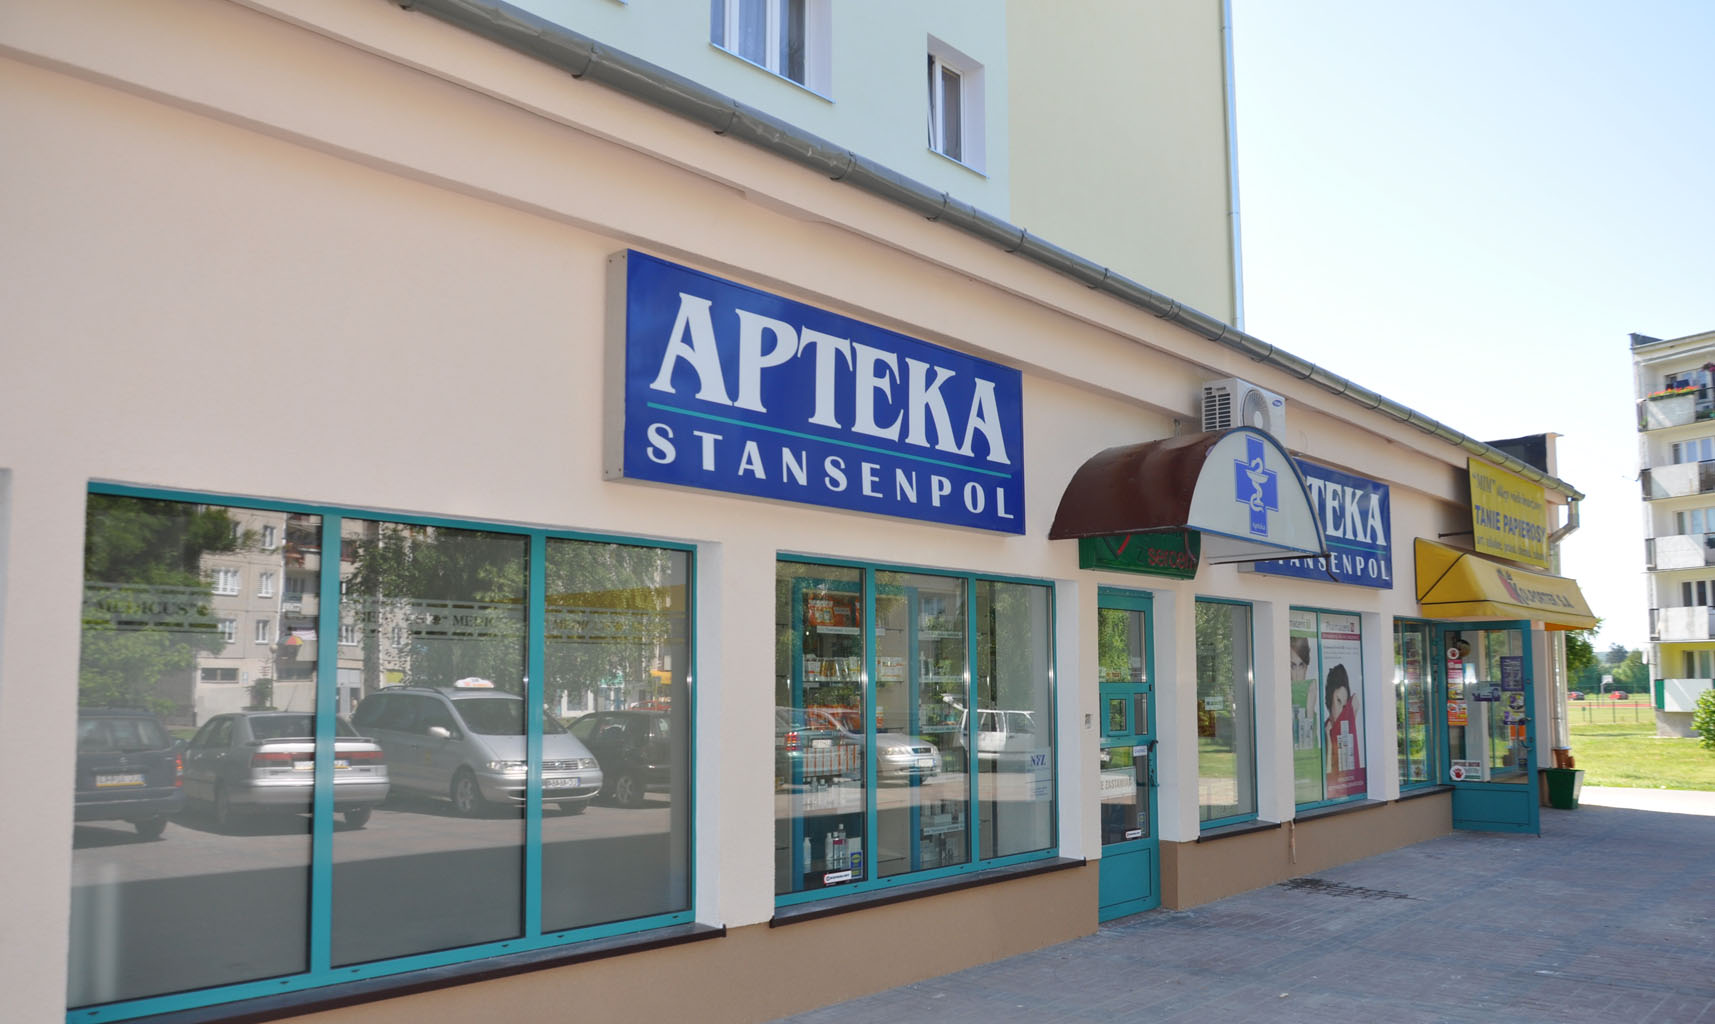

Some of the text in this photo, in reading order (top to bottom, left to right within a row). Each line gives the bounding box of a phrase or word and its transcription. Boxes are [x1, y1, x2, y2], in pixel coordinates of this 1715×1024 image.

[650, 292, 1011, 465] APTEKA
[646, 422, 1014, 519] STANSENPOL
[1306, 475, 1387, 546] TEKA
[1475, 504, 1546, 543] TANIE PAPIEROSY
[1264, 552, 1390, 580] SENPOL
